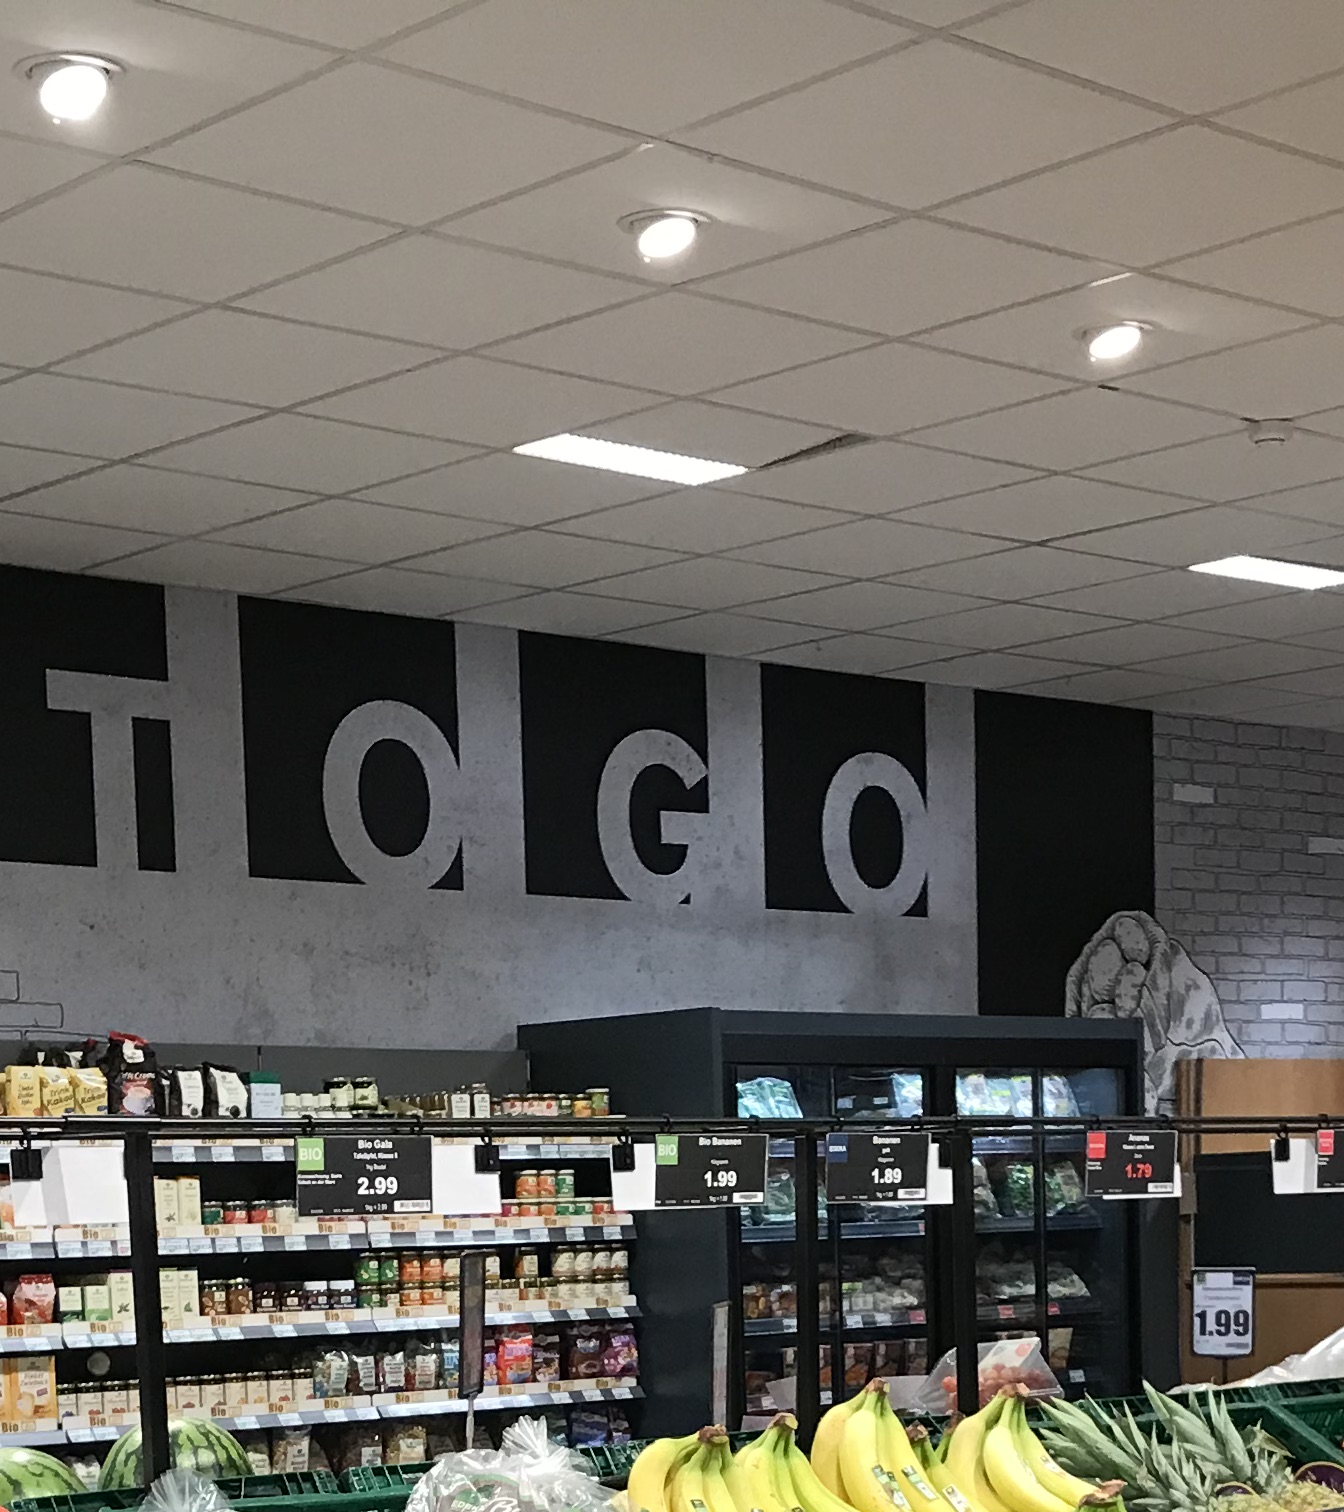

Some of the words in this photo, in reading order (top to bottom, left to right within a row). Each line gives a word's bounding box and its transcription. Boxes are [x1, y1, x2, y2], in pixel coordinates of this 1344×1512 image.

[358, 1140, 372, 1149] Bio
[374, 1139, 392, 1148] Gala
[699, 1137, 710, 1145] Bio
[713, 1137, 742, 1145] Bananen
[873, 1136, 901, 1145] Bananen
[300, 1148, 322, 1160] BIO
[658, 1144, 677, 1156] BIO
[871, 1168, 902, 1184] 1.89
[1125, 1163, 1153, 1179] 1.79
[704, 1171, 737, 1187] 1.99
[357, 1177, 398, 1195] 2.99
[82, 1229, 98, 1239] Bio
[1195, 1309, 1250, 1337] 1.99
[6, 1327, 24, 1337] Bio
[324, 1399, 339, 1409] Bio
[210, 1406, 226, 1417] Bio
[2, 1423, 19, 1432] Bio
